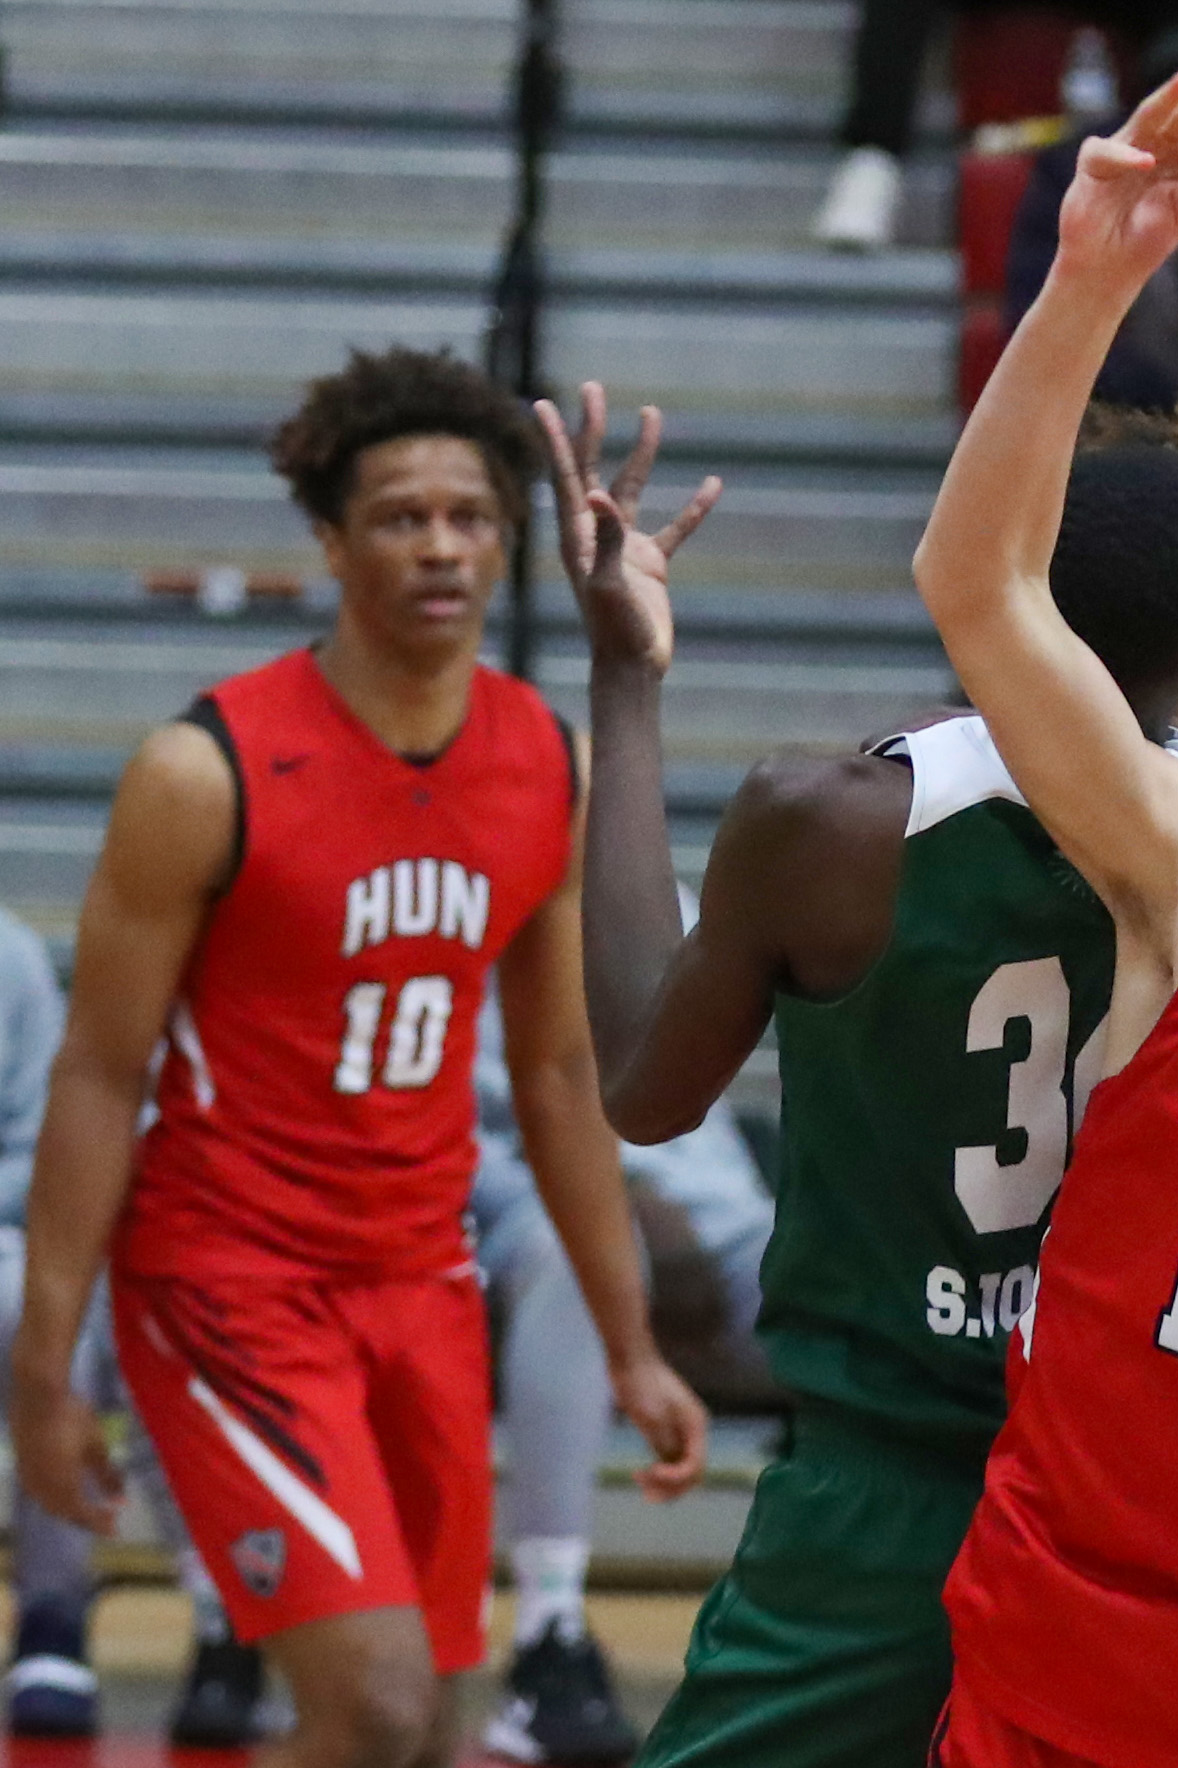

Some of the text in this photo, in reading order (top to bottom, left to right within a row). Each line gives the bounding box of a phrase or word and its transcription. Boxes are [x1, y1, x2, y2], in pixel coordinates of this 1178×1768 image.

[340, 856, 491, 959] HUN
[332, 973, 455, 1094] 10
[954, 955, 1110, 1235] 3
